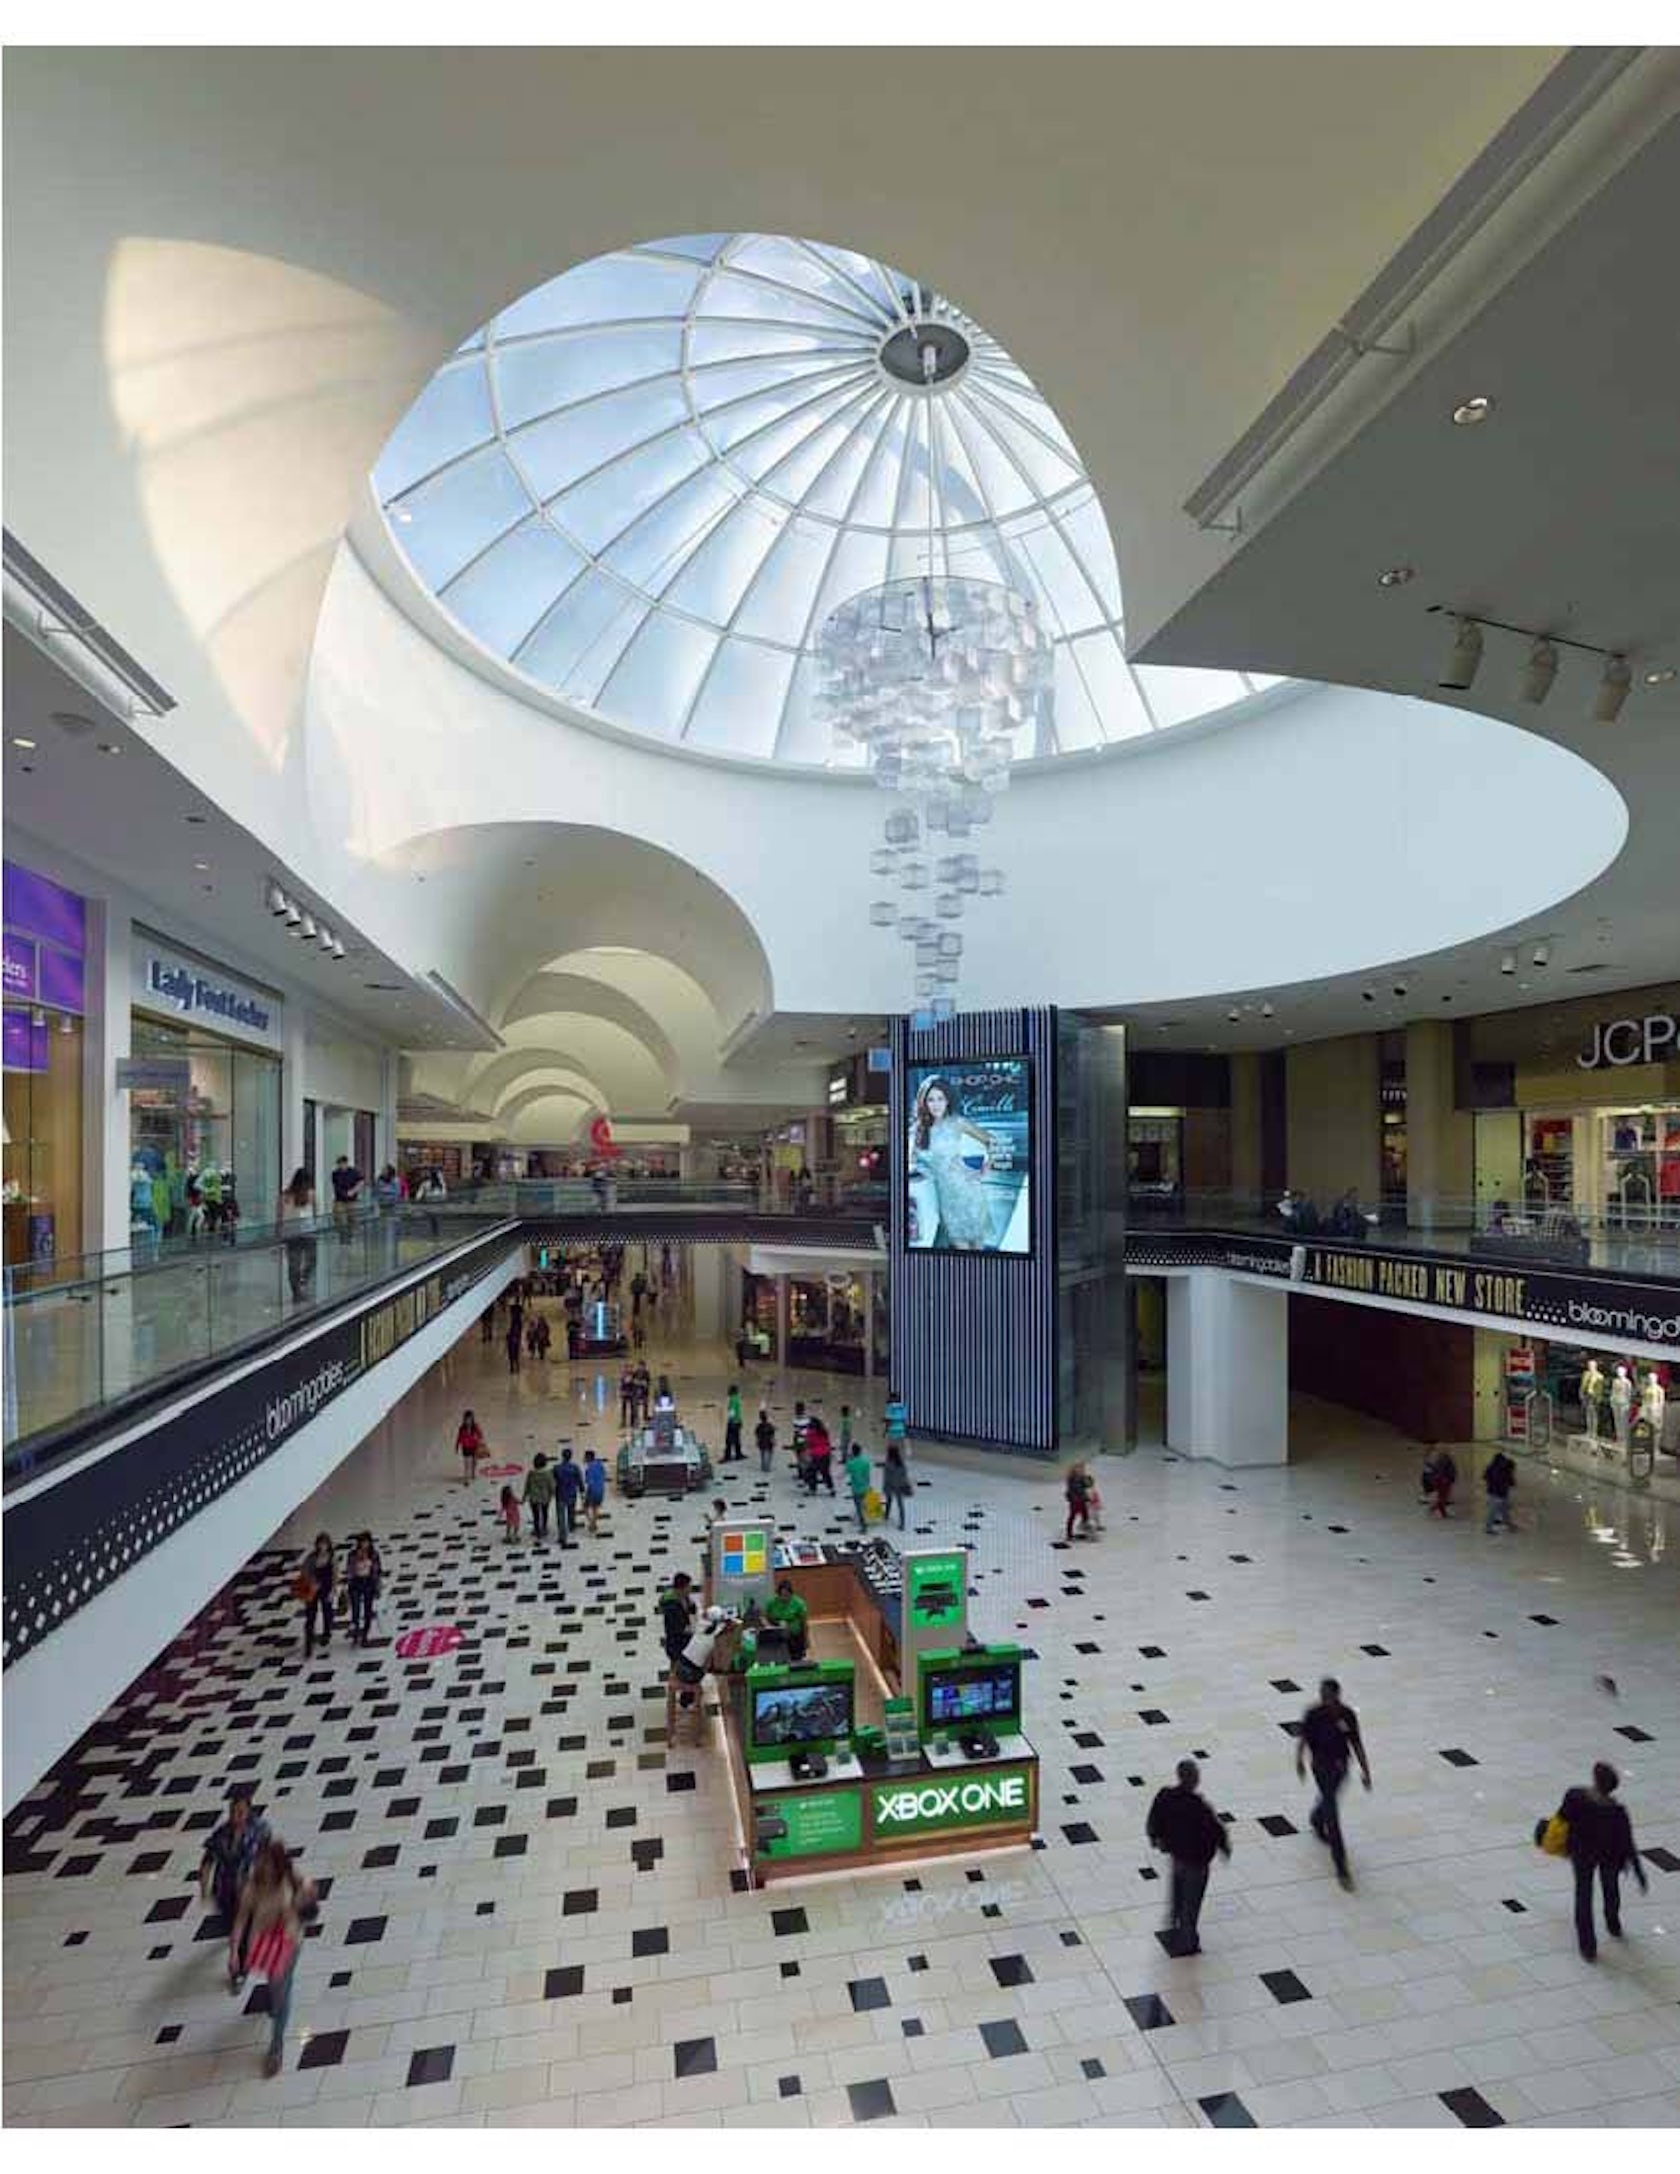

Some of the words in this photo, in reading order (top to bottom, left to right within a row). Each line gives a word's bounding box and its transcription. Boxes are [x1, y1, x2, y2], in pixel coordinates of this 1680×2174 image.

[1576, 1015, 1680, 1069] JCP
[1326, 1253, 1374, 1291] FASHION
[1379, 1260, 1428, 1299] PACKED
[1435, 1268, 1467, 1304] NEW
[1475, 1273, 1526, 1316] STORE
[877, 1786, 961, 1823] XBOX
[961, 1777, 1024, 1811] ONE
